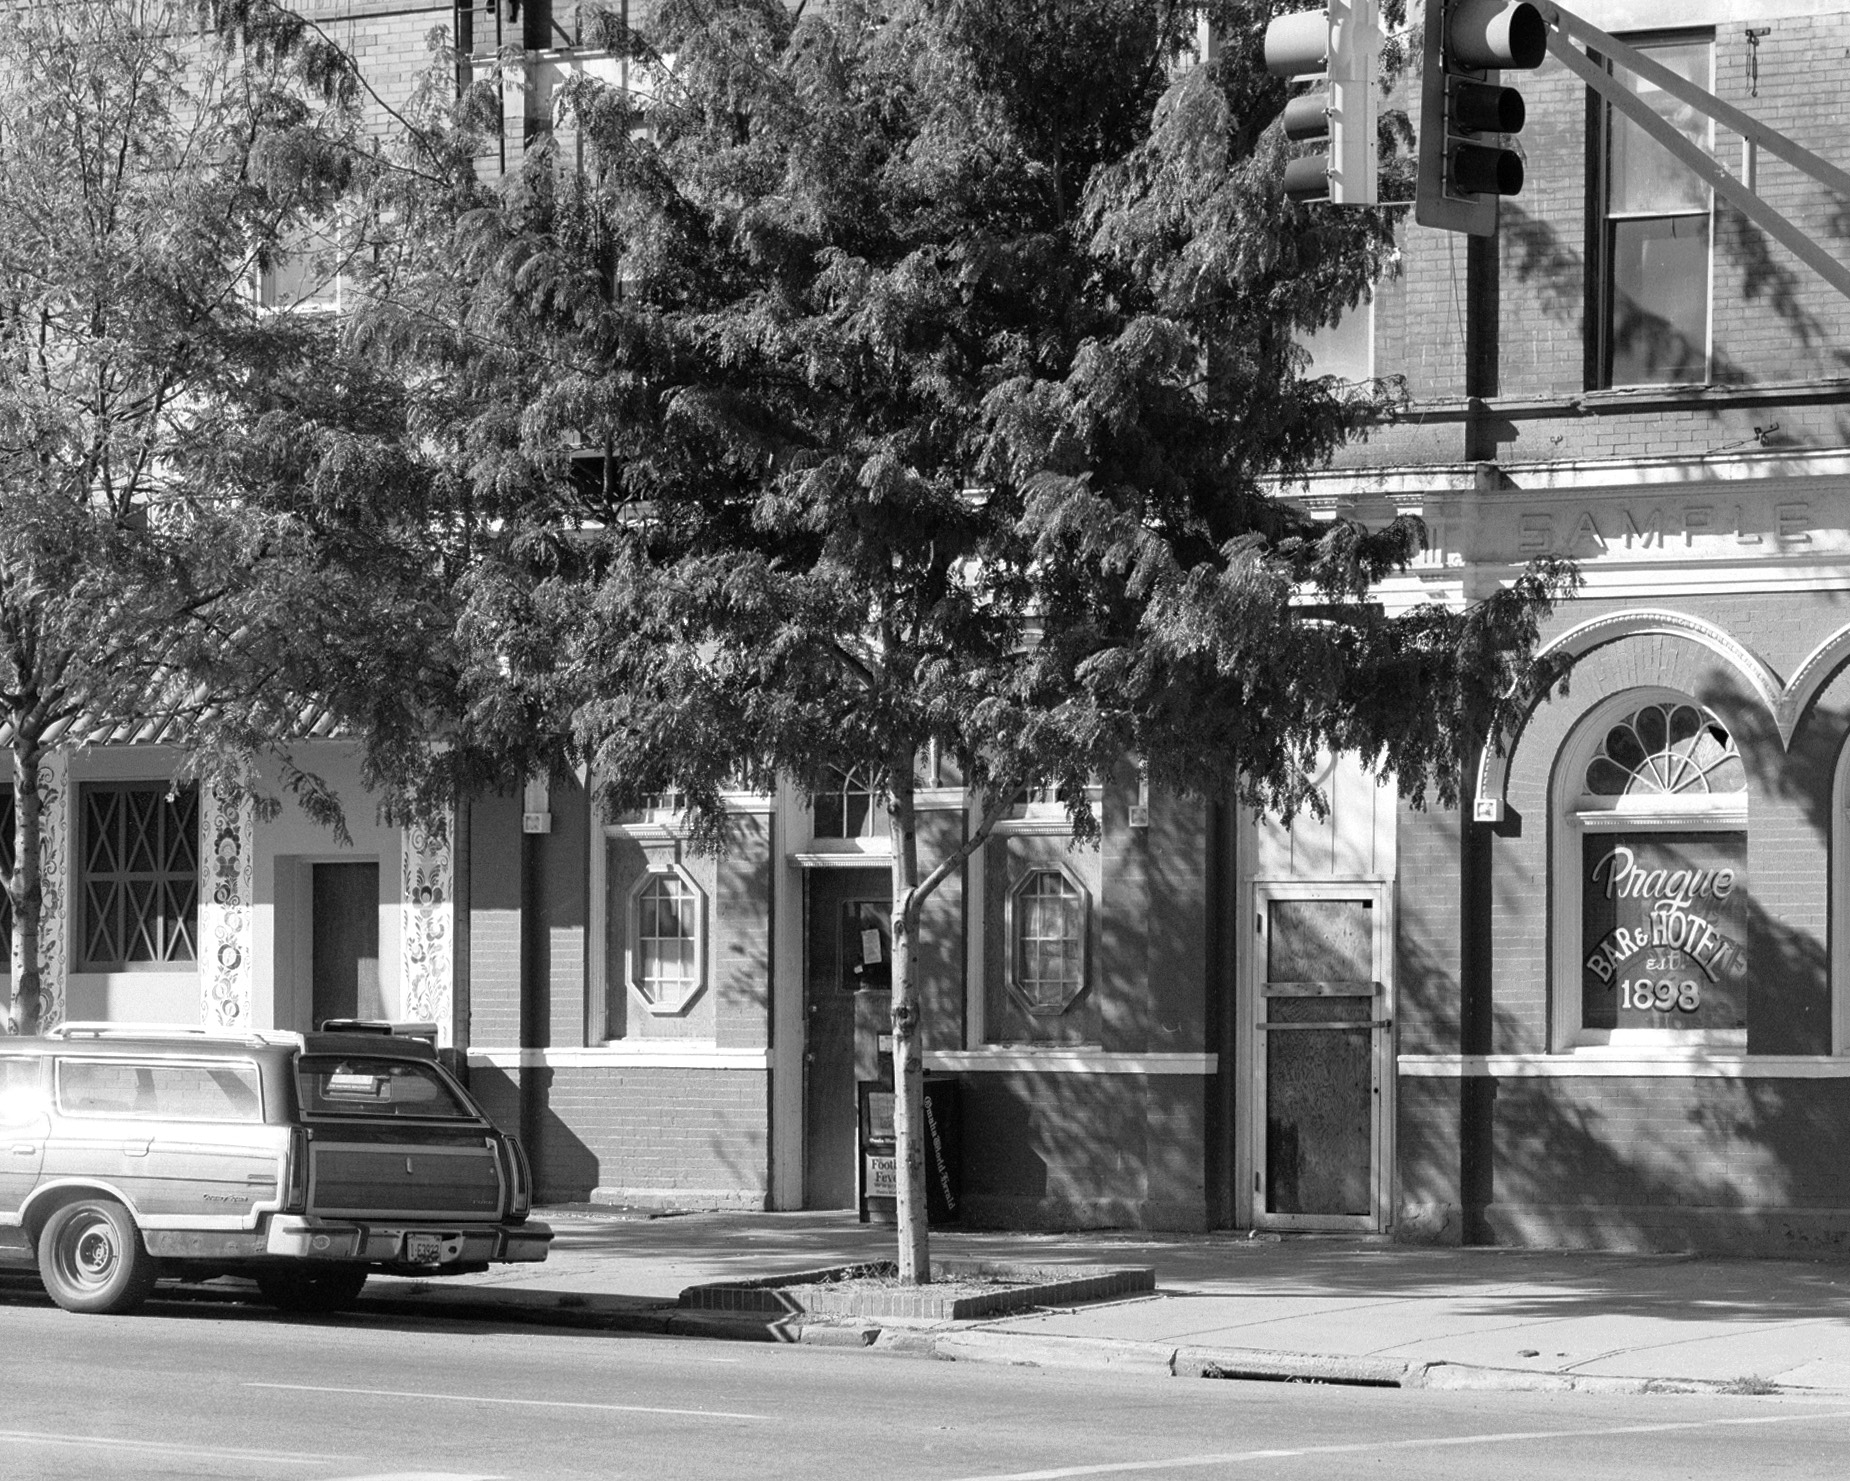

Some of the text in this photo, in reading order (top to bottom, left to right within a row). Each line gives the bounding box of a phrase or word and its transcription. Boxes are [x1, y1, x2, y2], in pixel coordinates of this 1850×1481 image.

[1519, 502, 1813, 554] SAMPLE
[1592, 846, 1735, 916] Prague
[1587, 910, 1720, 984] BAR & HOTEL
[1621, 978, 1701, 1013] 1898
